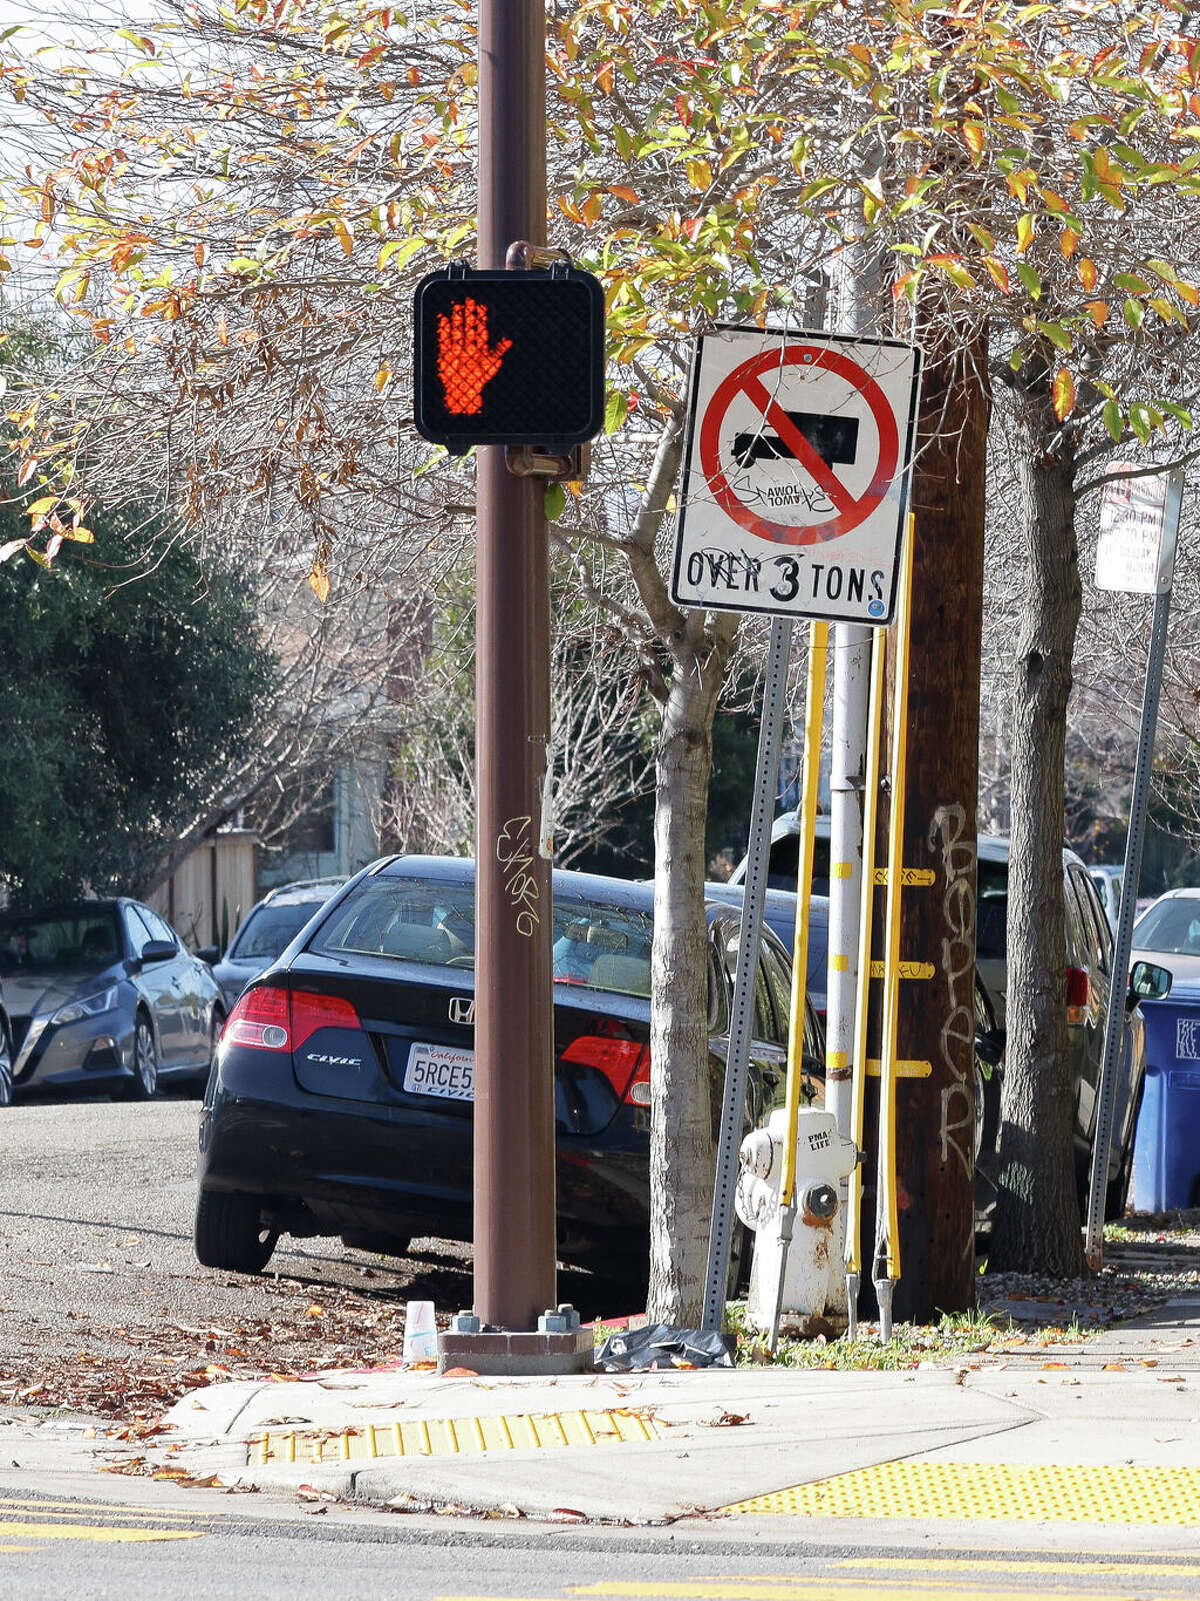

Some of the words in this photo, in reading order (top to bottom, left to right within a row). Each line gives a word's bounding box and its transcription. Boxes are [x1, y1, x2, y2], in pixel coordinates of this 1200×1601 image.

[687, 551, 762, 593] OVER
[770, 556, 800, 602] 3
[811, 563, 885, 602] TONS
[307, 1053, 361, 1065] CIVIC
[414, 1060, 474, 1089] 5RCE5
[808, 1131, 828, 1143] PMA
[810, 1139, 830, 1151] LIFE
